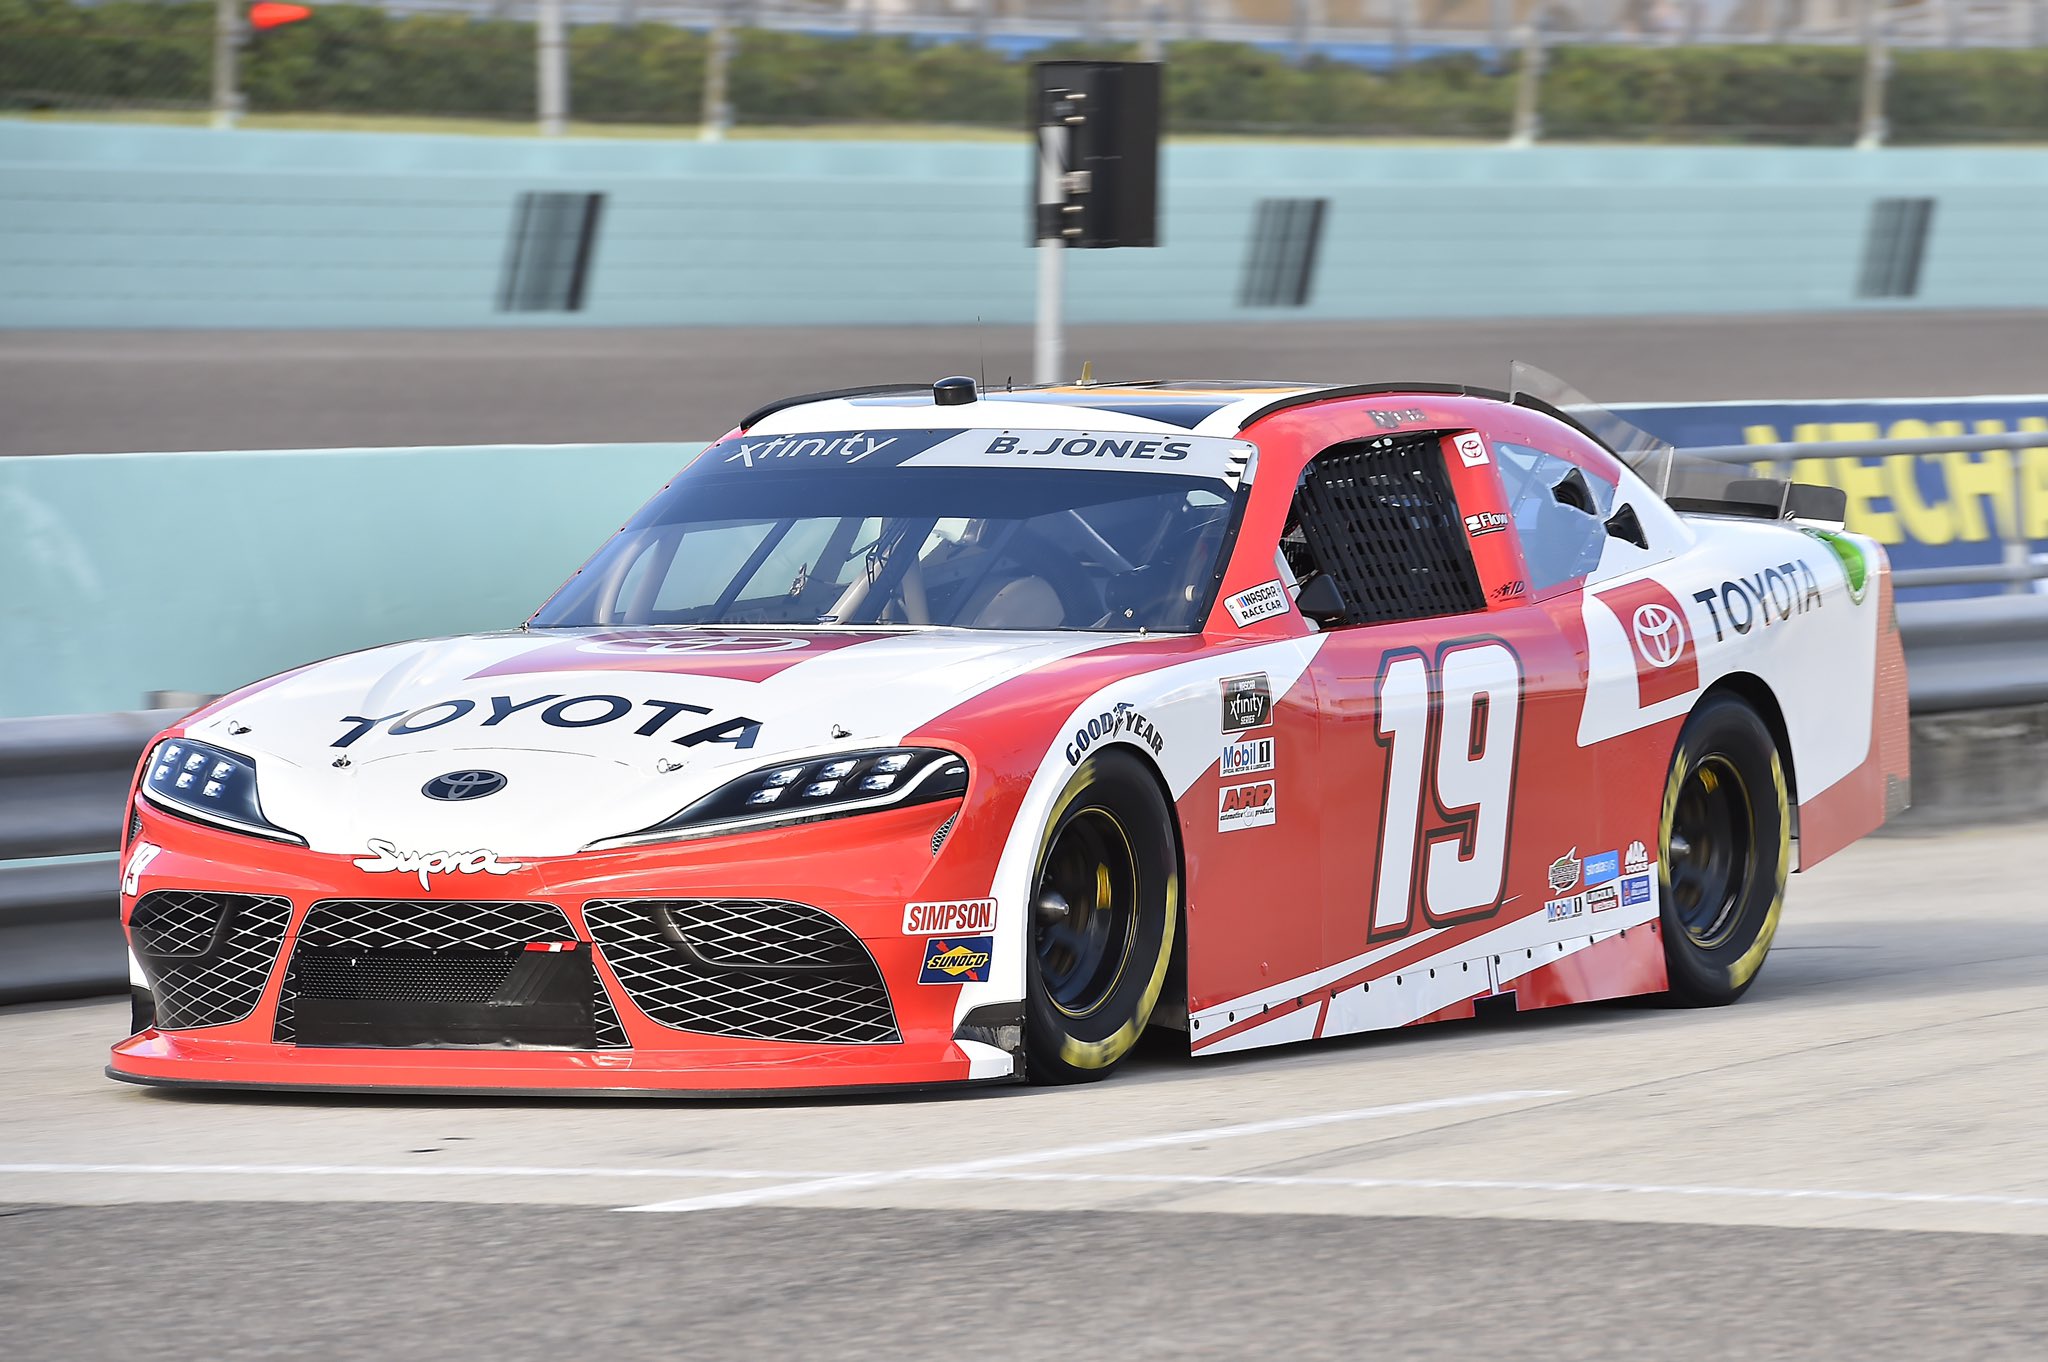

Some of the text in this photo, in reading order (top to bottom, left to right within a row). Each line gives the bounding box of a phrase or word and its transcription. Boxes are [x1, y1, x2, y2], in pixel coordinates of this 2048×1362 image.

[724, 432, 898, 468] xfinity
[1241, 599, 1283, 620] RACE CAR
[1243, 585, 1279, 606] NASCAR
[1692, 559, 1822, 642] TOYOTA
[1230, 692, 1264, 721] xfinity
[1240, 714, 1256, 725] SERIES
[329, 694, 764, 750] TOYOTA
[1223, 741, 1270, 768] Mobil 1
[1221, 783, 1272, 812] ARP
[1371, 638, 1523, 936] 19
[121, 840, 162, 897] 19
[353, 838, 523, 892] Supra
[908, 902, 991, 931] SIMPSON
[1547, 899, 1572, 919] Mobil
[1574, 897, 1581, 913] 1
[929, 954, 986, 968] SUNOCO
